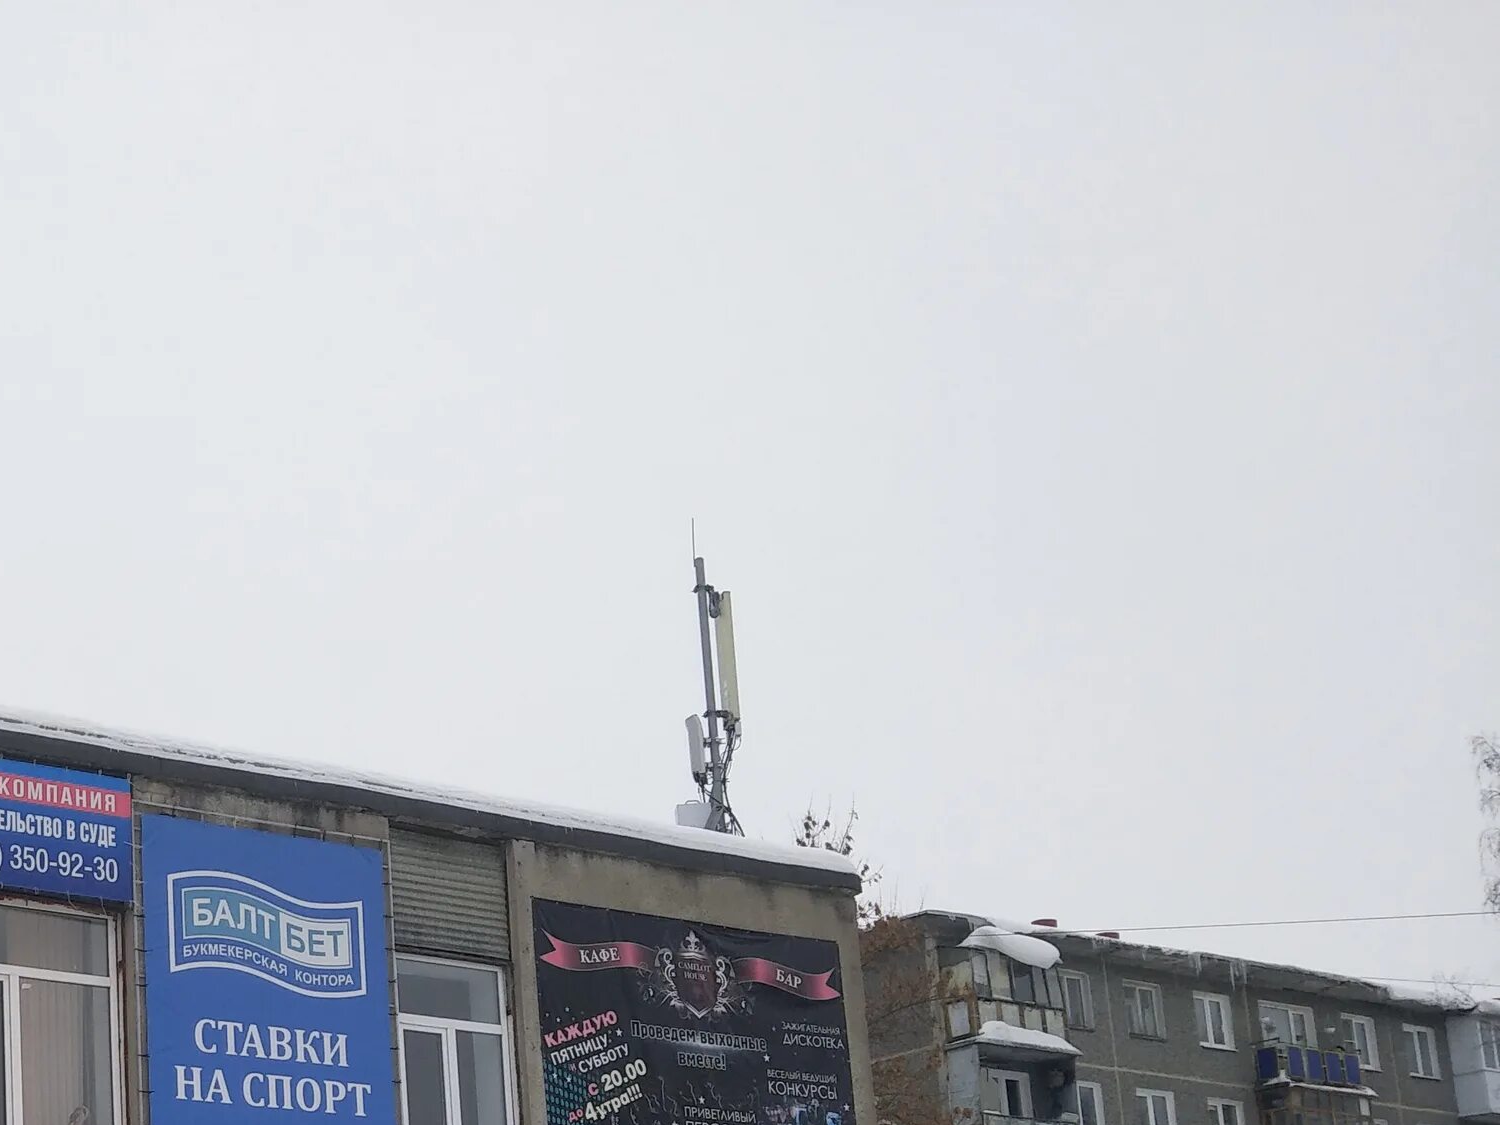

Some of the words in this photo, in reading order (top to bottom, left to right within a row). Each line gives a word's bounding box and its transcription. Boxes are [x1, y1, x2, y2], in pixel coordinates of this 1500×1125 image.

[66, 820, 76, 842] В
[79, 822, 117, 849] СУДЕ
[9, 844, 118, 884] 350-92-30
[183, 943, 288, 976] БУКМЕКЕРСКАЯ
[294, 969, 354, 987] КОНТОРА
[579, 947, 621, 964] КАФЕ
[775, 968, 803, 989] БАР
[194, 1018, 349, 1068] СТАВКИ
[544, 1010, 618, 1048] КАЖДУЮ
[630, 1020, 696, 1043] Проведем
[700, 1031, 767, 1052] выходные
[781, 1021, 840, 1035] ЗАЖИГАТЕЛЬНАЯ
[783, 1032, 845, 1050] ДИСКОТЕКА
[550, 1034, 608, 1065] ПЯТНИЦУ
[578, 1043, 629, 1073] СУББОТУ
[677, 1052, 726, 1070] вместе!
[601, 1058, 647, 1092] 20.00
[768, 1080, 838, 1100] КОНКУРСЫ
[174, 1064, 233, 1105] НА
[242, 1072, 372, 1118] СПОРТ
[684, 1105, 757, 1124] ПРИВЕТЛИВЫЙ
